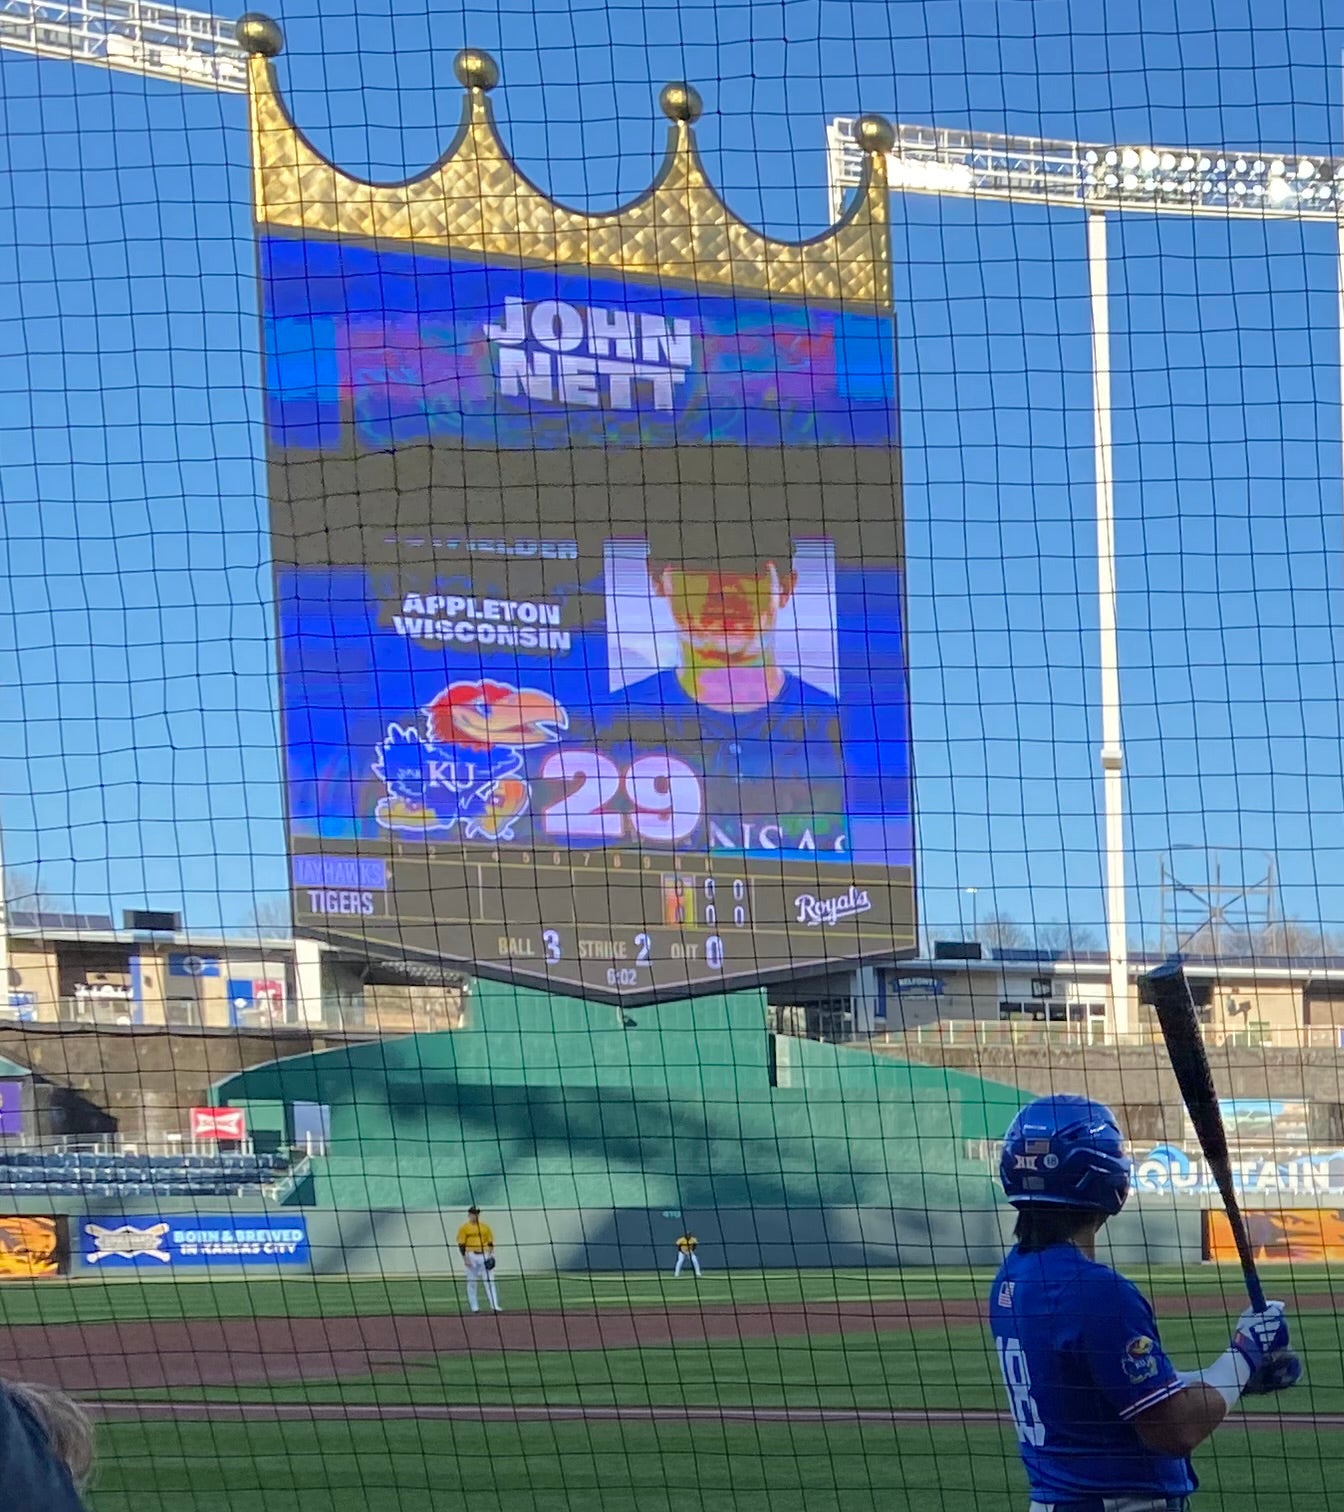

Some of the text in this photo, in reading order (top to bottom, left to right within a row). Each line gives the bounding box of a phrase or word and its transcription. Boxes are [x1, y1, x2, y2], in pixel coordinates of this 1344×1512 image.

[483, 295, 693, 368] JOHN
[499, 347, 685, 411] NETT
[402, 592, 561, 626] APPLETON
[392, 616, 572, 650] WISCONSIN
[427, 761, 474, 790] KU
[541, 750, 702, 840] 29
[703, 877, 717, 899] 0
[732, 878, 745, 900] 0
[793, 886, 872, 926] Royals
[307, 889, 374, 915] TIGERS
[704, 904, 717, 927] 0
[733, 905, 745, 927] 0
[497, 928, 725, 970] BALL 3 STRIKE 2 OUT 0
[606, 967, 638, 987] 6:02
[235, 1229, 304, 1243] BREWED
